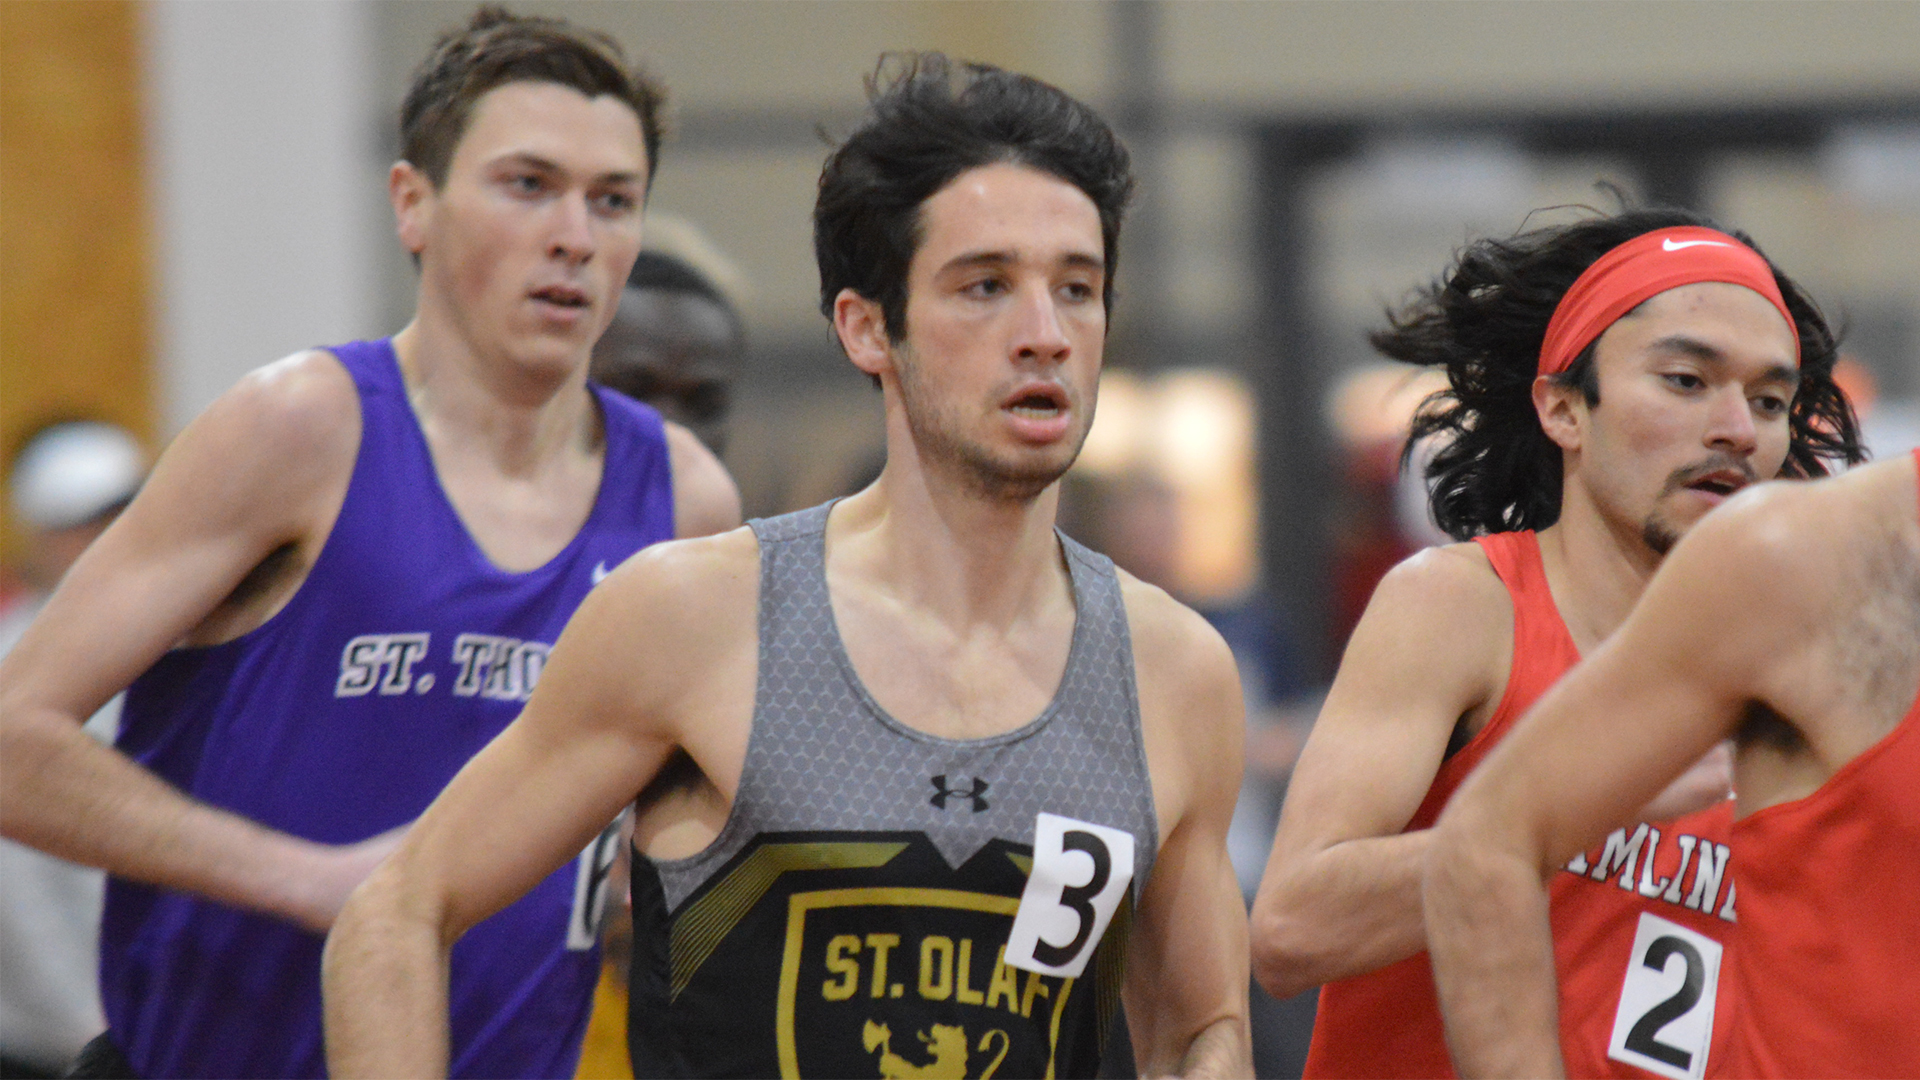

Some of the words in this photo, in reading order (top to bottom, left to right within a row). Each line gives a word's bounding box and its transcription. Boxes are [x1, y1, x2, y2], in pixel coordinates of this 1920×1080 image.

[335, 632, 436, 698] ST.
[1031, 829, 1112, 968] 3
[1559, 821, 1738, 923] MLIN
[822, 932, 904, 1001] ST.
[1623, 934, 1706, 1072] 2
